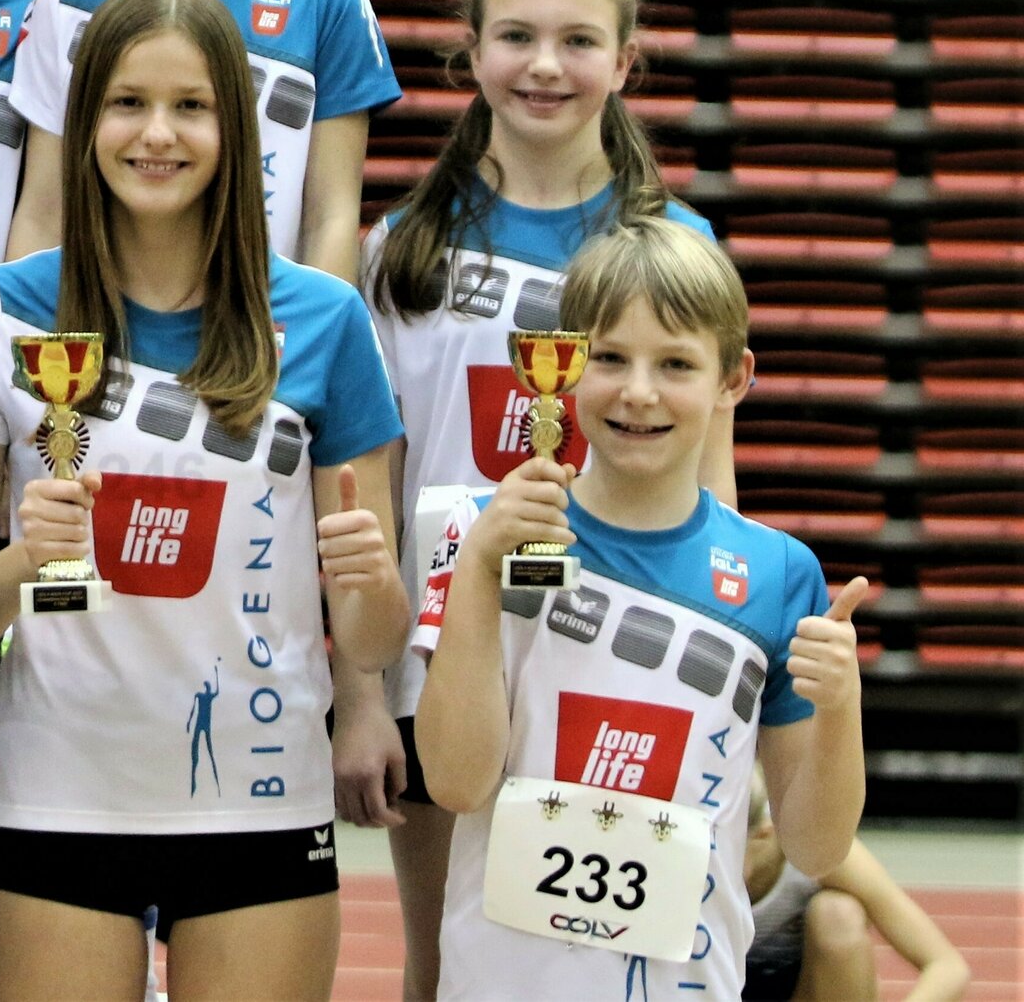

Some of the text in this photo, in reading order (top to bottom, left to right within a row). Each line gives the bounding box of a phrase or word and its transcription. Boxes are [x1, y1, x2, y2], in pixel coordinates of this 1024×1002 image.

[129, 498, 189, 535] long
[120, 526, 181, 565] life
[242, 486, 285, 798] BIOGENA
[551, 610, 597, 636] erima
[593, 720, 657, 761] long
[580, 747, 646, 791] life
[535, 846, 648, 912] 233
